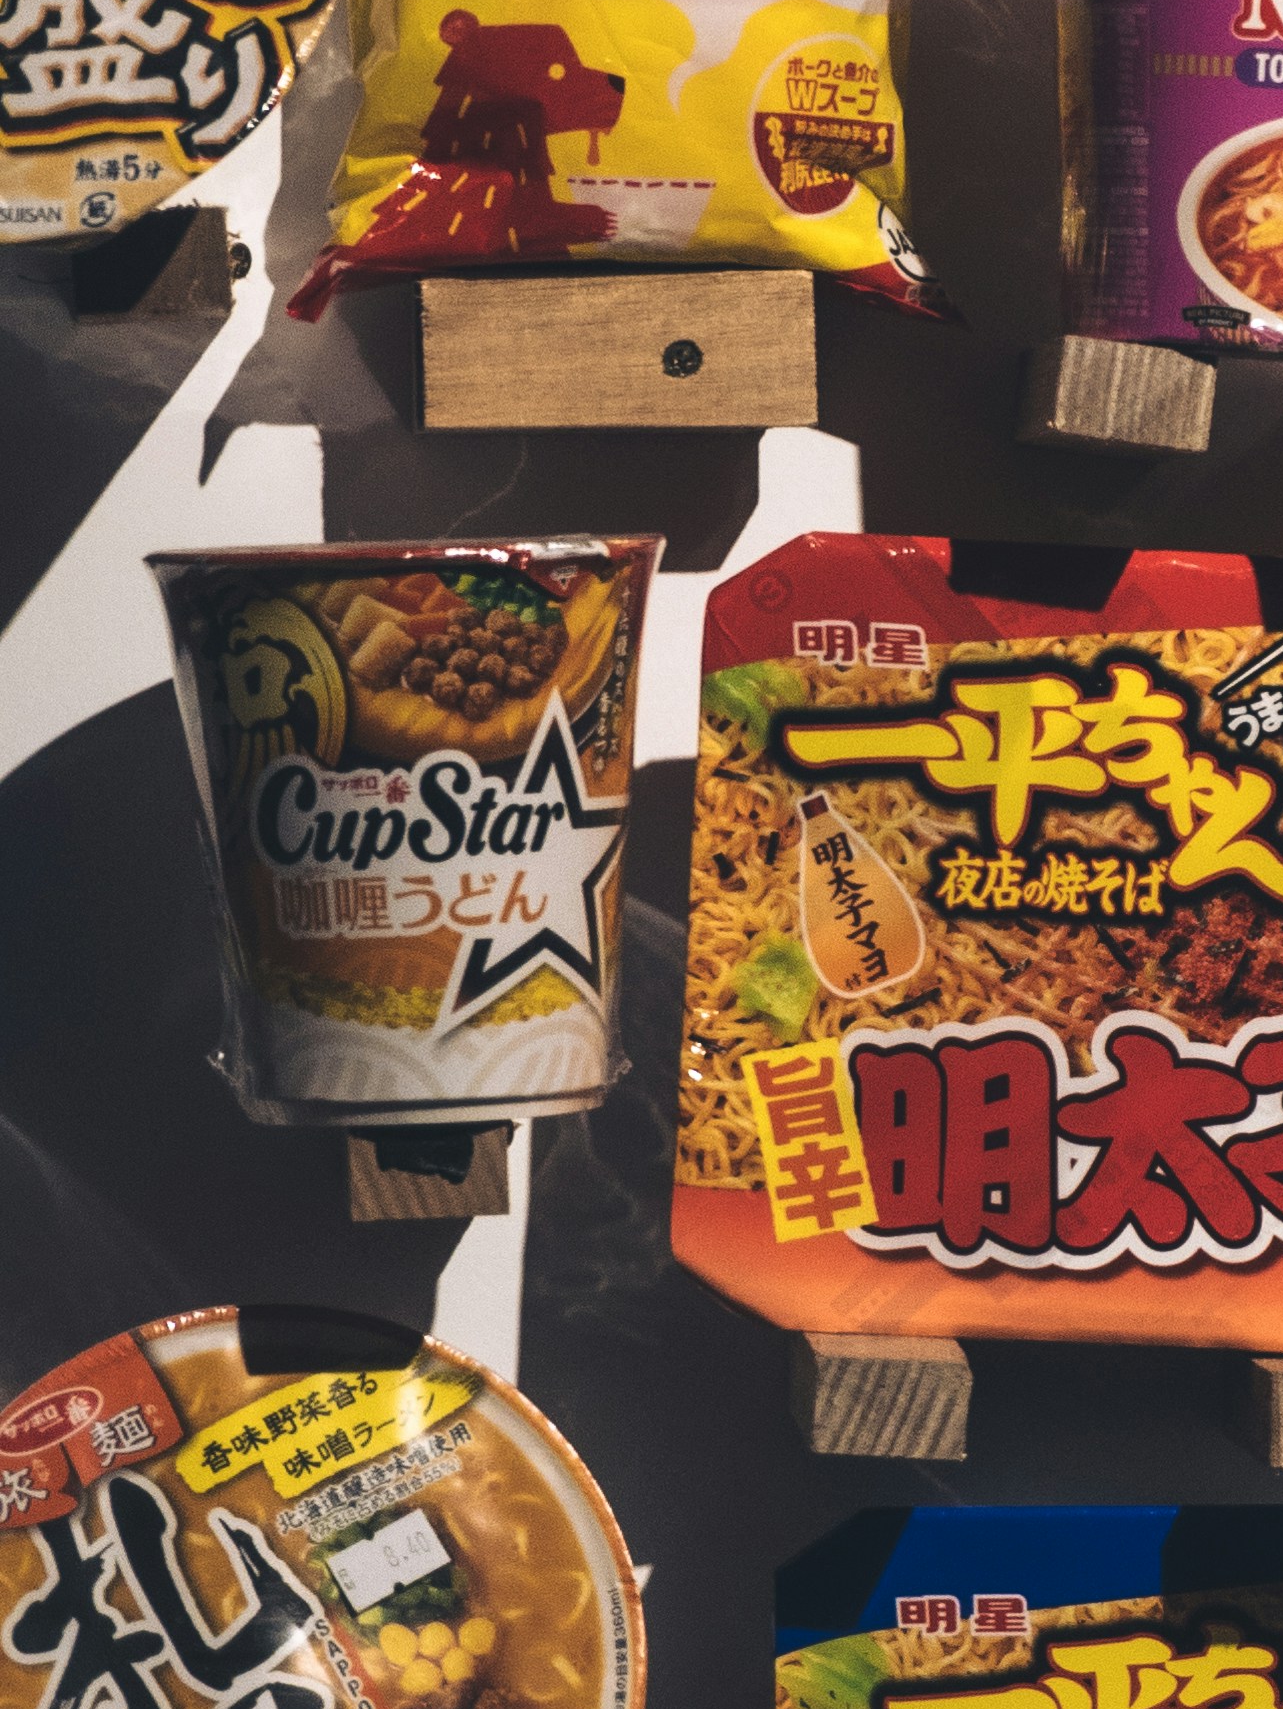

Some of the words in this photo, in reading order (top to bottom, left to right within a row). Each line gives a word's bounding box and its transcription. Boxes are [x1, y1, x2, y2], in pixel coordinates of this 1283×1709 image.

[791, 618, 929, 670] 明星
[936, 852, 1172, 918] 夜店の焼そば
[894, 1593, 1031, 1636] 明星
